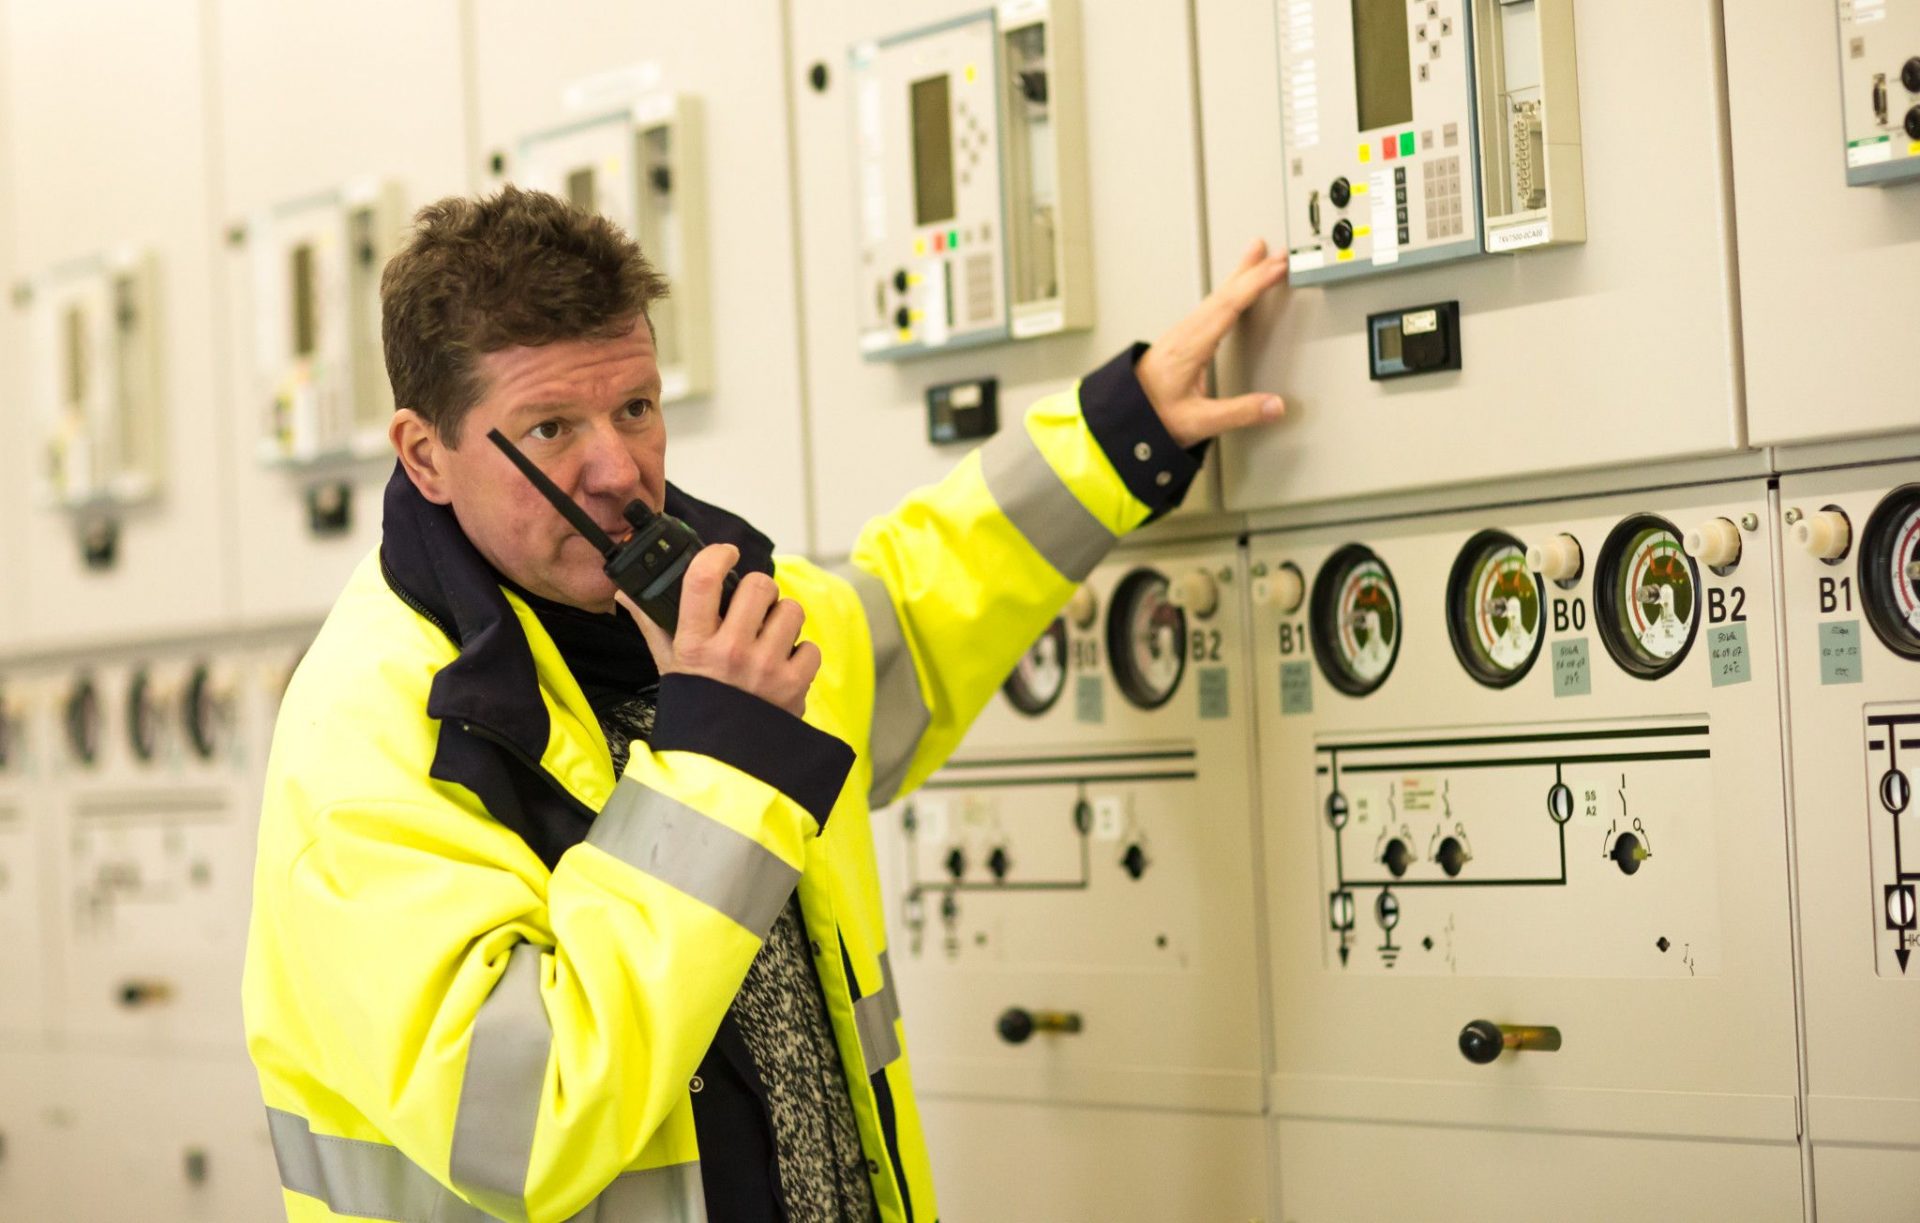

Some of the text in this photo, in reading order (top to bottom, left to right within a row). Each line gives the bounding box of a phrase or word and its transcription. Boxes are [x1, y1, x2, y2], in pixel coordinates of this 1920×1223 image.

[1707, 586, 1747, 623] B2
[1819, 576, 1852, 613] B1
[1192, 628, 1222, 661] B2
[1279, 622, 1305, 655] B1
[1586, 805, 1597, 816] A2
